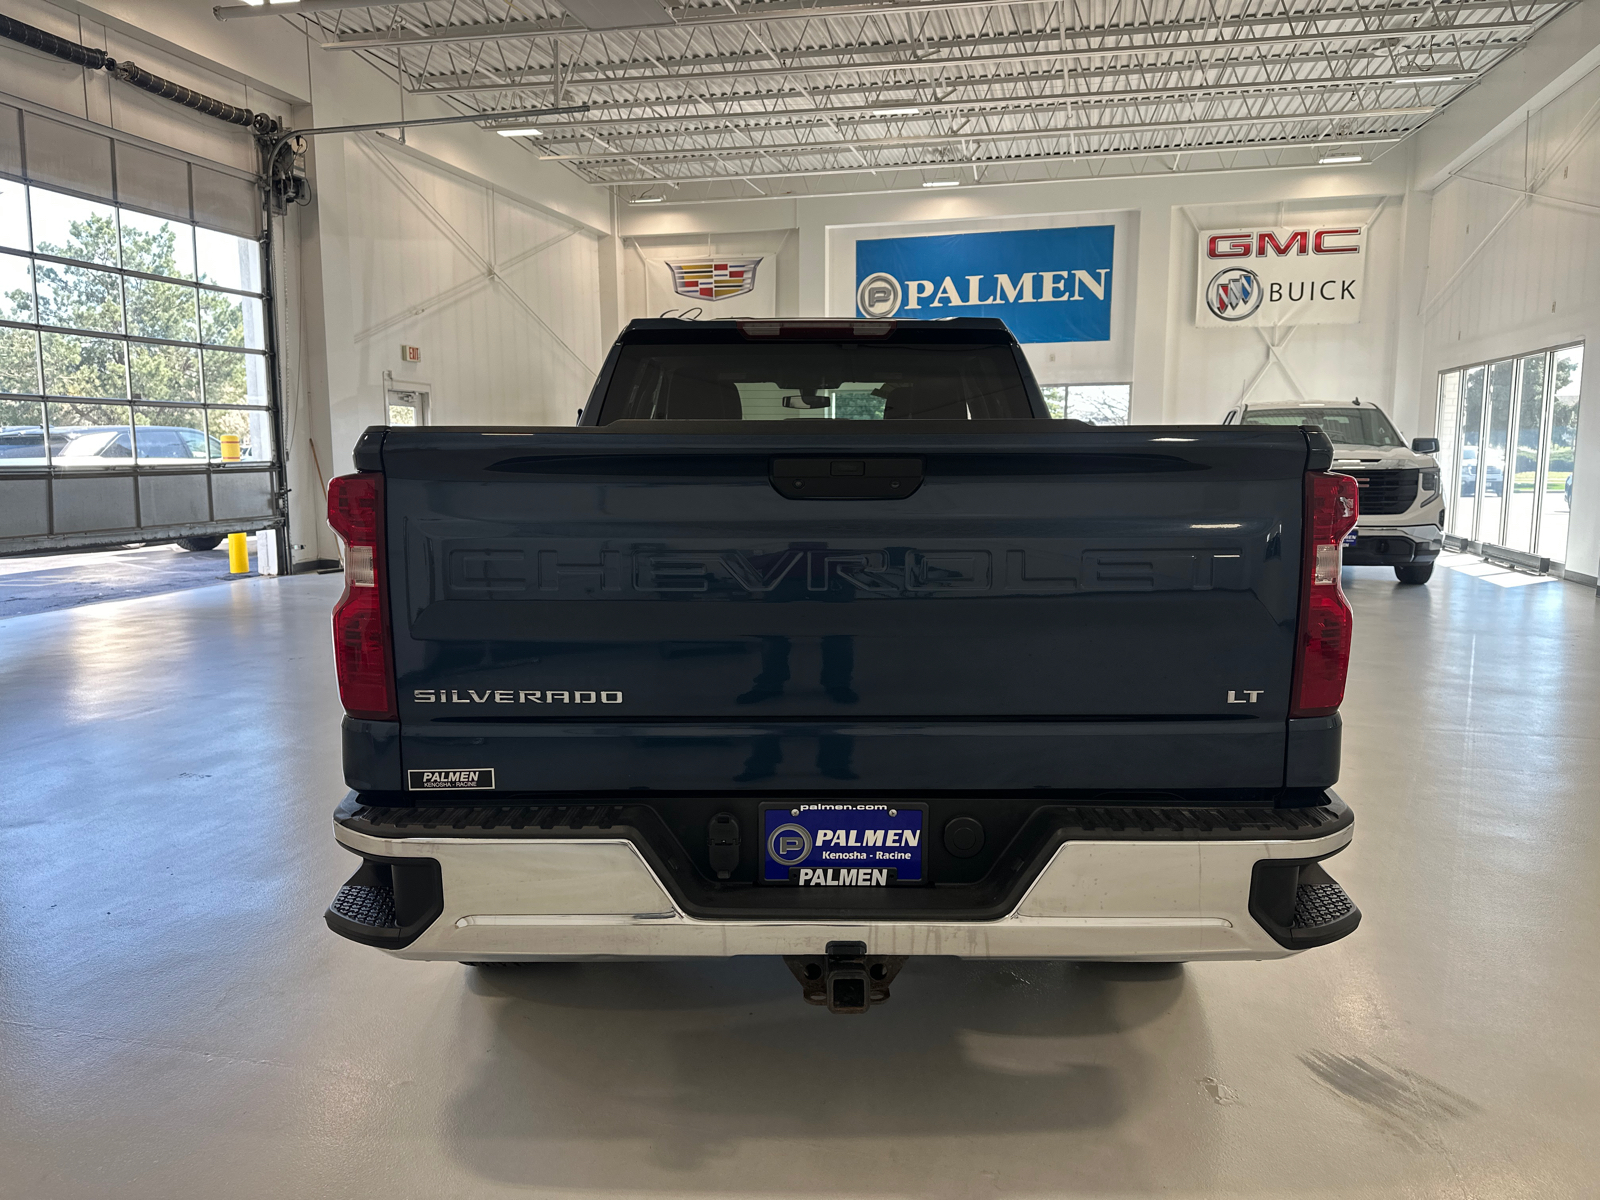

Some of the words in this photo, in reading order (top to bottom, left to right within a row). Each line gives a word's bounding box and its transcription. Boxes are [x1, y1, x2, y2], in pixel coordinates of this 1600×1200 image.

[1207, 227, 1362, 260] GMC
[904, 269, 1110, 310] PALMEN
[1269, 280, 1356, 302] BUICK
[409, 346, 419, 361] EXIT
[449, 547, 1242, 592] CHEVROLET
[413, 689, 623, 704] SILVERADO
[1227, 690, 1265, 704] LT
[423, 771, 479, 782] PALMEN
[800, 803, 888, 811] palmen.com
[815, 829, 921, 847] PALMEN
[822, 851, 867, 860] Kenosha
[876, 851, 912, 860] Racine
[799, 868, 888, 887] PALMEN
